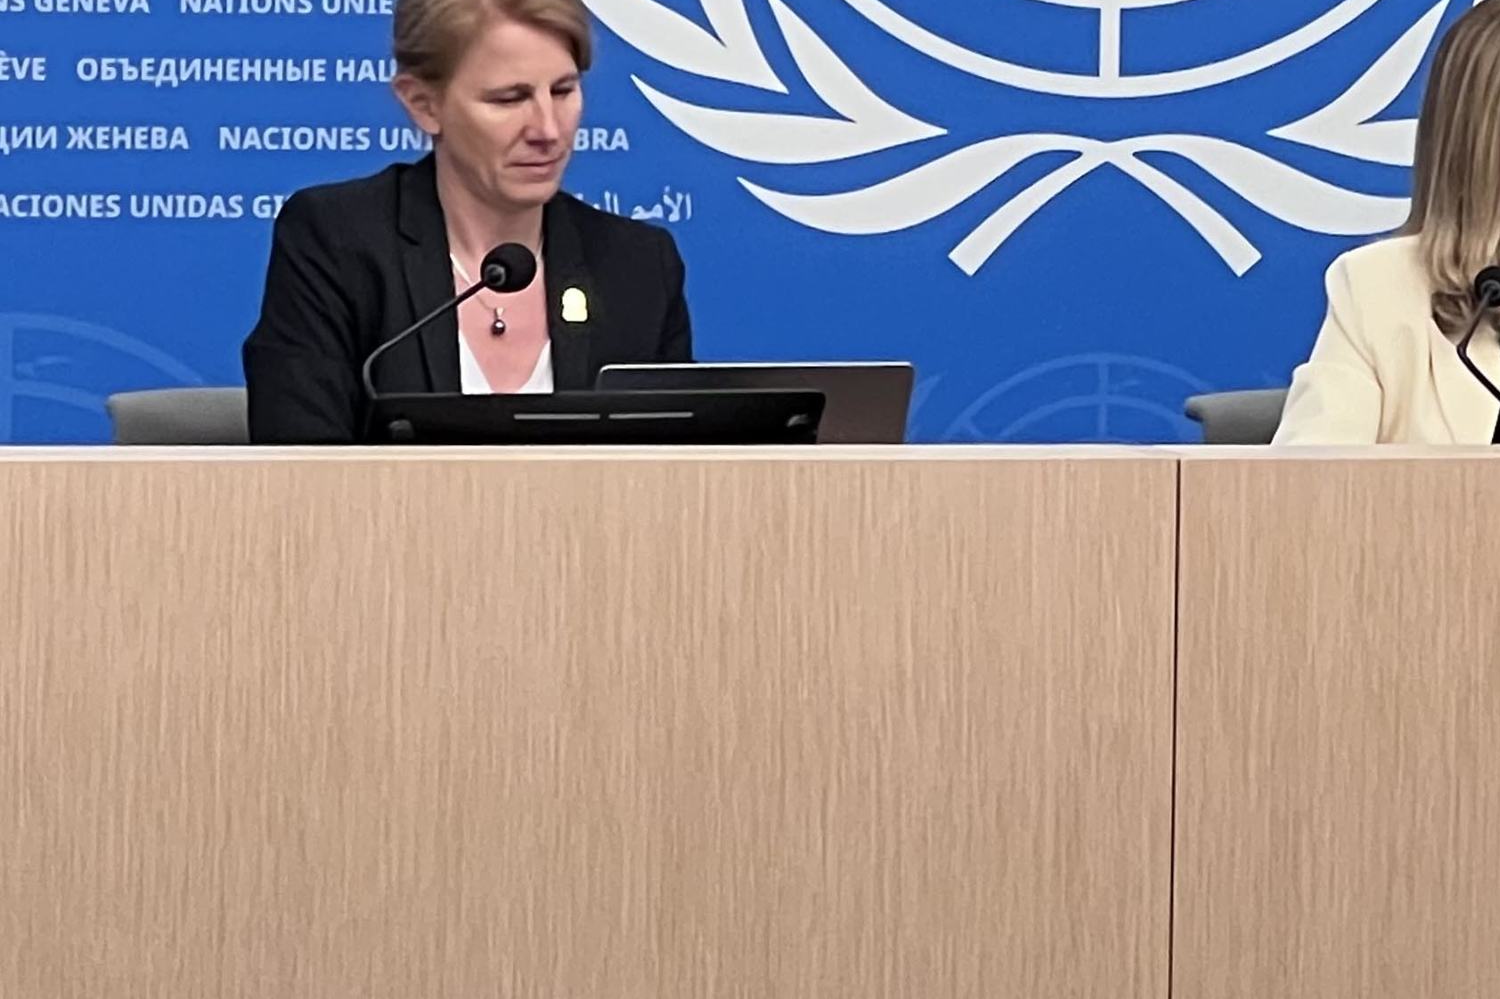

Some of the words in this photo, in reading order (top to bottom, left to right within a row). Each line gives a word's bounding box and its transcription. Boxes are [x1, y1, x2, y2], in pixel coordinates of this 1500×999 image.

[76, 57, 327, 88] ОБЪЕДИНЕННЫЕ
[66, 126, 189, 150] ЖЕНЕВА
[219, 126, 371, 151] NACIONES
[130, 194, 244, 219] UNIDAS
